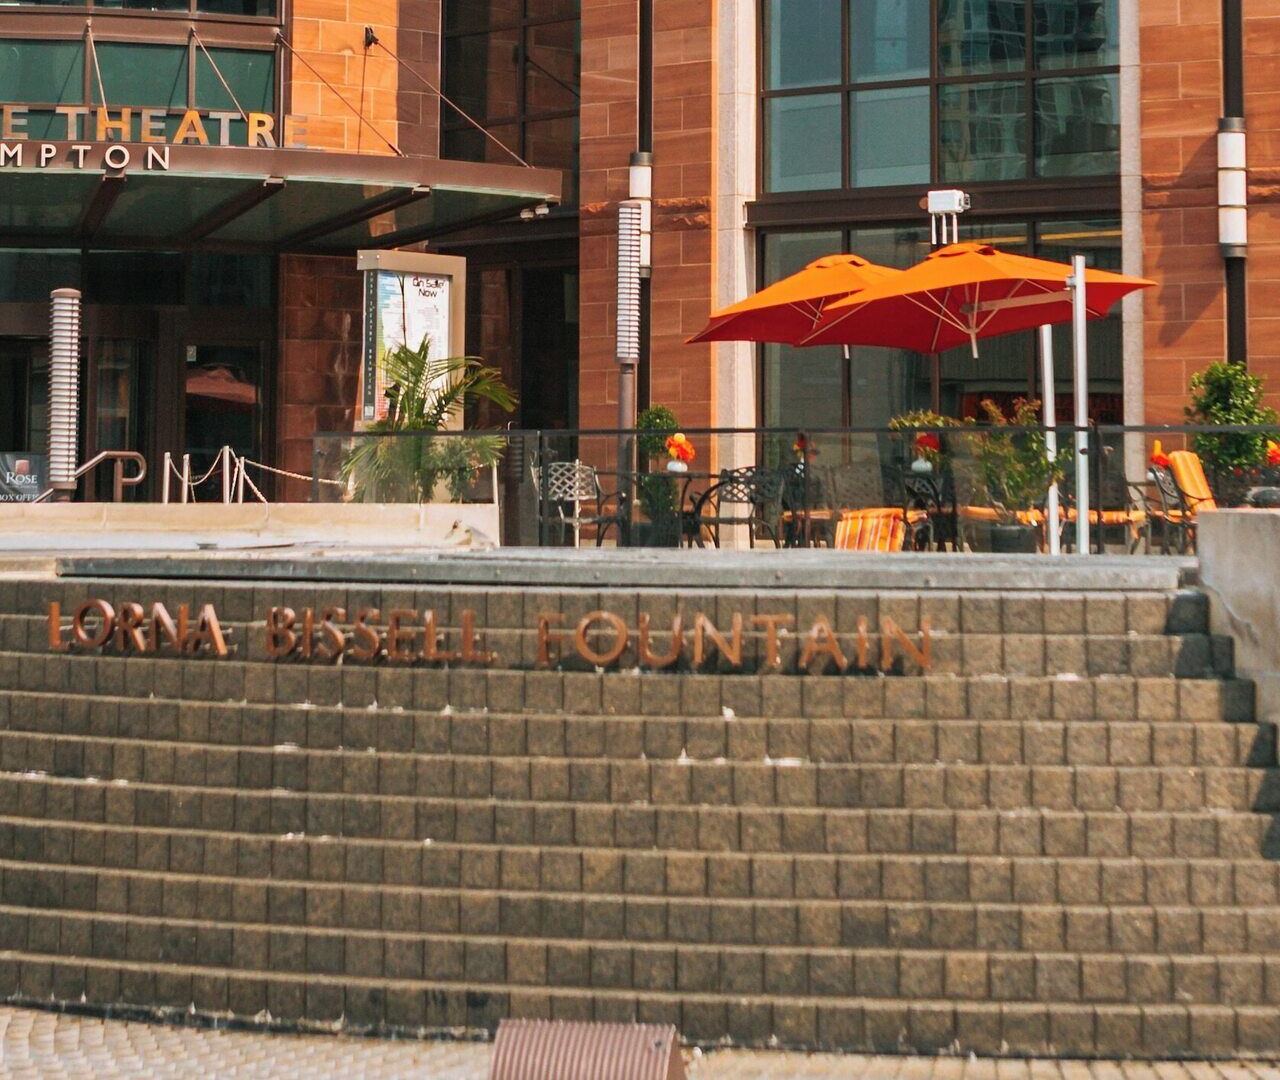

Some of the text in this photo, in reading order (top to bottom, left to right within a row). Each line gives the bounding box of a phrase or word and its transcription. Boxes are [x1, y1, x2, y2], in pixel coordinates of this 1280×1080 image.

[56, 106, 309, 149] THEATRE
[418, 288, 437, 297] Now
[5, 471, 38, 485] ROSE
[49, 598, 931, 670] LORNA BISSELL FOUNTAIN
